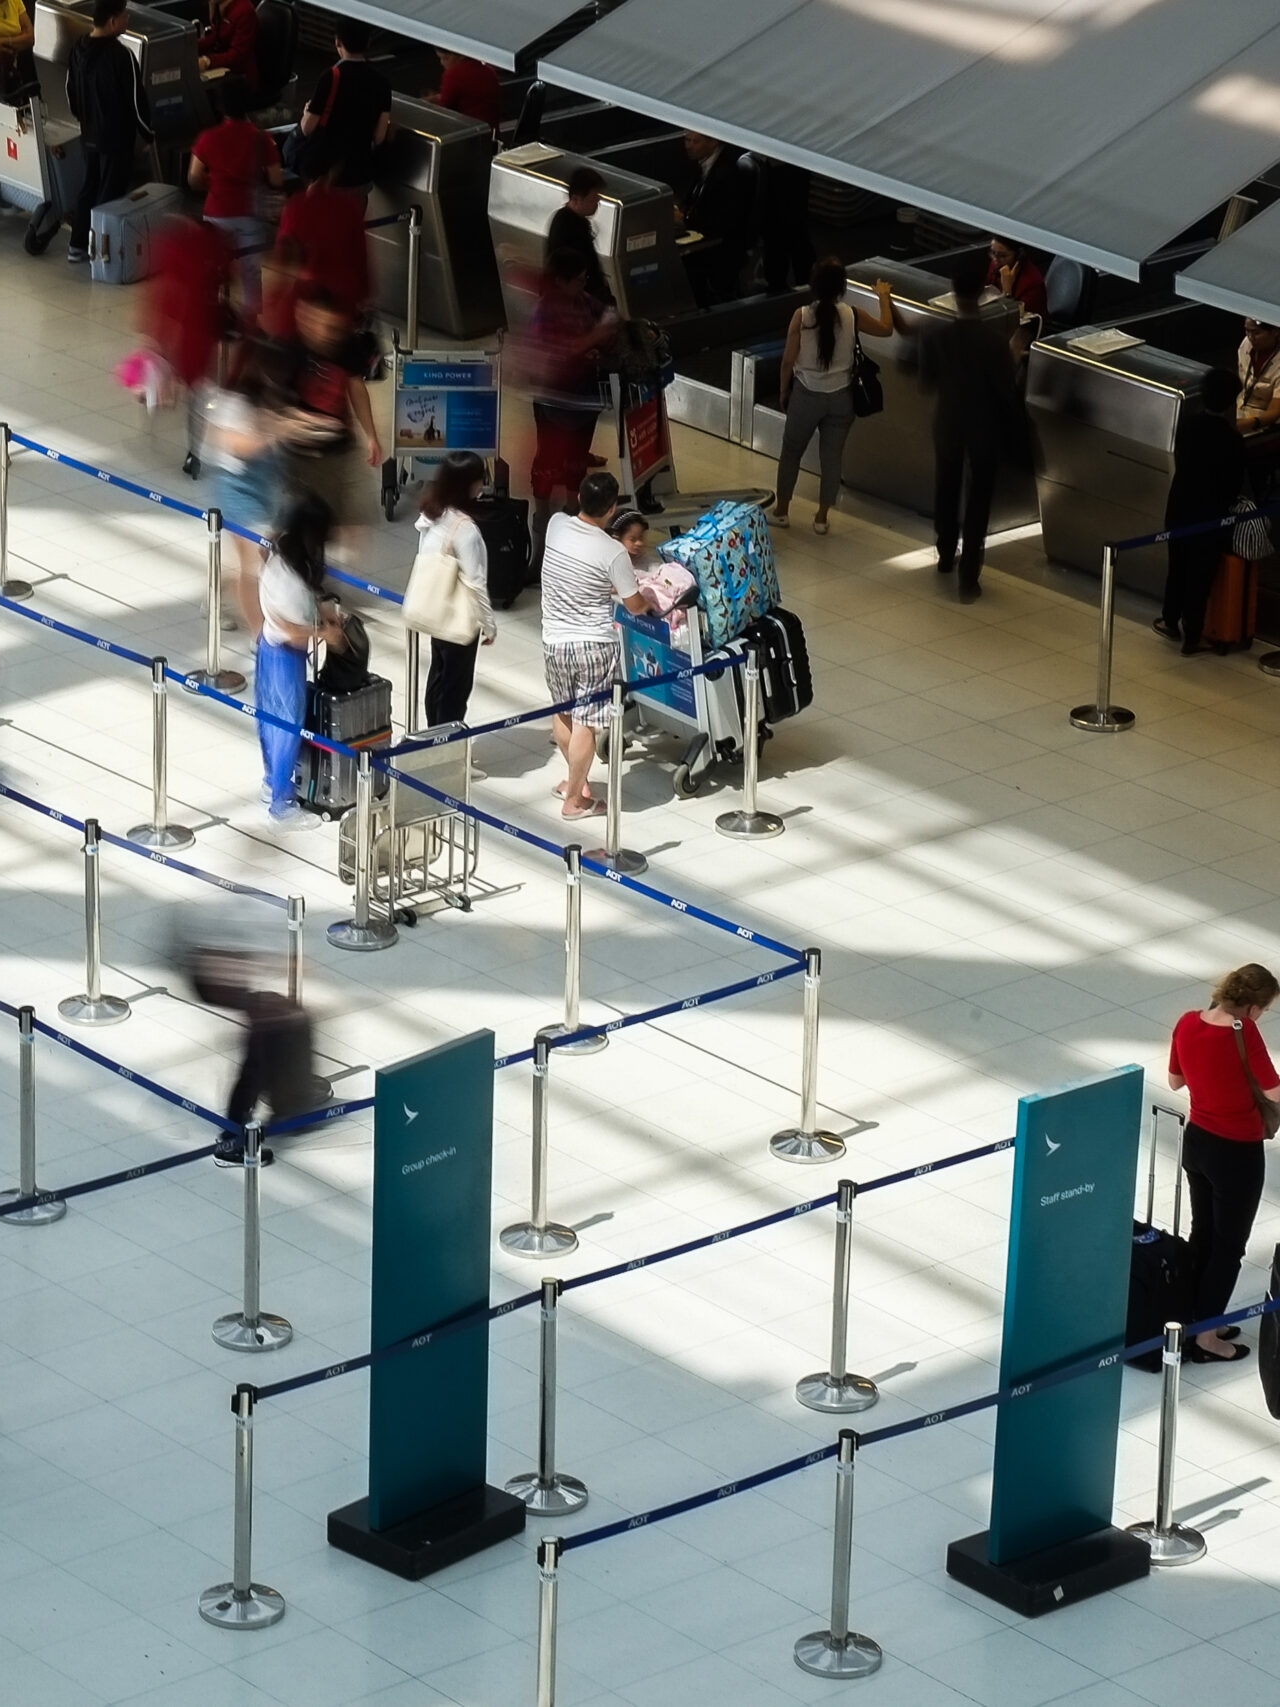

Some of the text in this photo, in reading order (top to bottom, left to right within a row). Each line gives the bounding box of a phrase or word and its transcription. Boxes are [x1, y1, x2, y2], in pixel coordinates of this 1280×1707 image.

[47, 450, 59, 460] AOT
[98, 471, 111, 482] AOT
[149, 492, 162, 503] AOT
[1220, 516, 1236, 526] AOT
[260, 538, 272, 548] AOT
[1155, 532, 1170, 542] AOT
[367, 583, 380, 594] AOT
[41, 616, 55, 627] AOT
[97, 639, 111, 650] AOT
[677, 669, 694, 679] AOT
[185, 679, 200, 690] AOT
[575, 696, 592, 706] AOT
[242, 705, 256, 716] AOT
[504, 716, 521, 727] AOT
[300, 729, 315, 740] AOT
[433, 735, 450, 745] AOT
[386, 767, 401, 779] AOT
[444, 795, 460, 808] AOT
[49, 810, 64, 821] AOT
[503, 825, 518, 836] AOT
[150, 852, 167, 864] AOT
[606, 869, 622, 883] AOT
[671, 899, 687, 912] AOT
[737, 927, 754, 941] AOT
[757, 972, 775, 985] AOT
[681, 997, 700, 1009] AOT
[605, 1020, 624, 1032] AOT
[57, 1033, 72, 1046] AOT
[118, 1067, 134, 1079] AOT
[181, 1099, 197, 1112] AOT
[326, 1106, 345, 1117] AOT
[215, 1139, 236, 1151] AOT
[994, 1139, 1012, 1150] AOT
[402, 1146, 457, 1175] Group check-in
[126, 1167, 146, 1179] AOT
[914, 1163, 934, 1176] AOT
[36, 1193, 57, 1204] AOT
[1040, 1182, 1095, 1206] Staff stand-by
[793, 1202, 813, 1215] AOT
[712, 1231, 731, 1243] AOT
[627, 1259, 645, 1271] AOT
[496, 1302, 517, 1315] AOT
[1246, 1303, 1265, 1316] AOT
[412, 1333, 432, 1348] AOT
[1098, 1354, 1119, 1368] AOT
[325, 1364, 347, 1378] AOT
[1011, 1384, 1032, 1397] AOT
[924, 1412, 945, 1425] AOT
[805, 1451, 825, 1464] AOT
[717, 1484, 738, 1497] AOT
[628, 1514, 649, 1528] AOT
